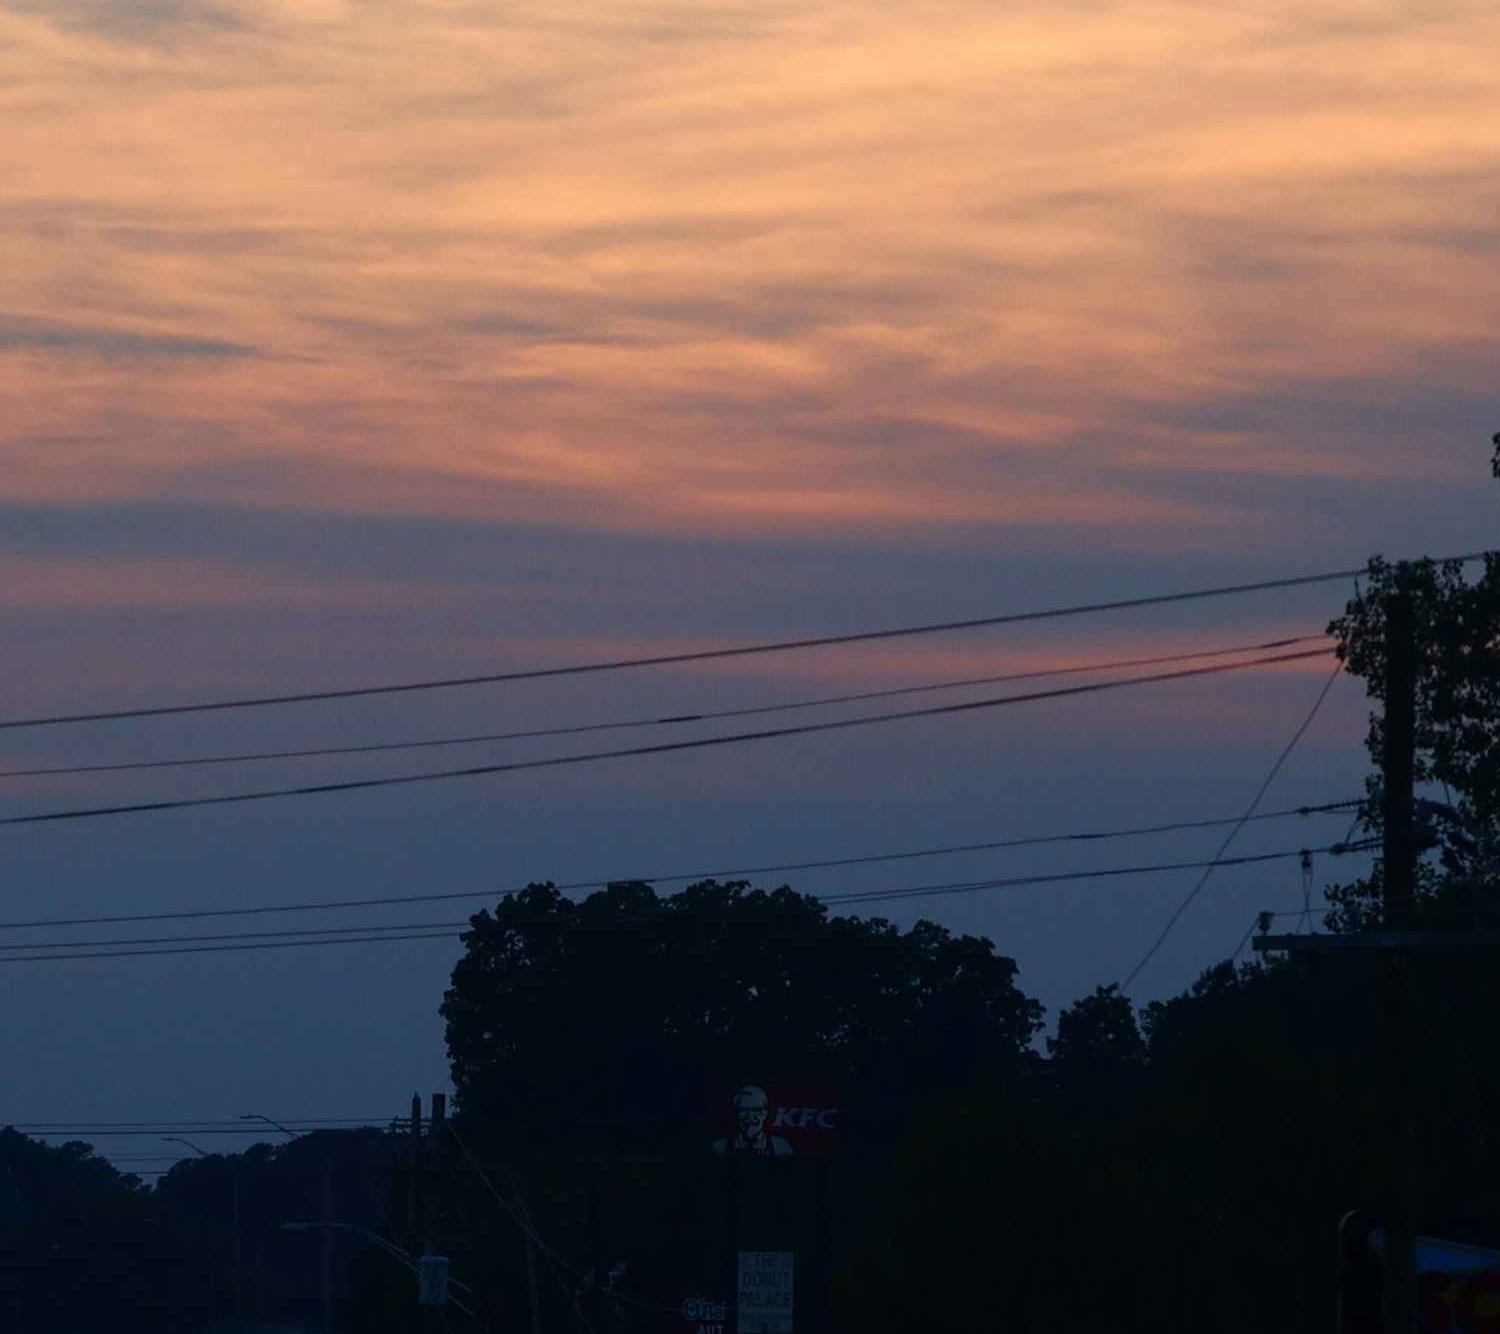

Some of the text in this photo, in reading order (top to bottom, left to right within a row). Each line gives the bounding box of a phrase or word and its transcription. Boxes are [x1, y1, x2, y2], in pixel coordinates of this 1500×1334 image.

[771, 1106, 838, 1130] KFC
[743, 1272, 790, 1288] DONUT
[740, 1291, 791, 1308] PALACE
